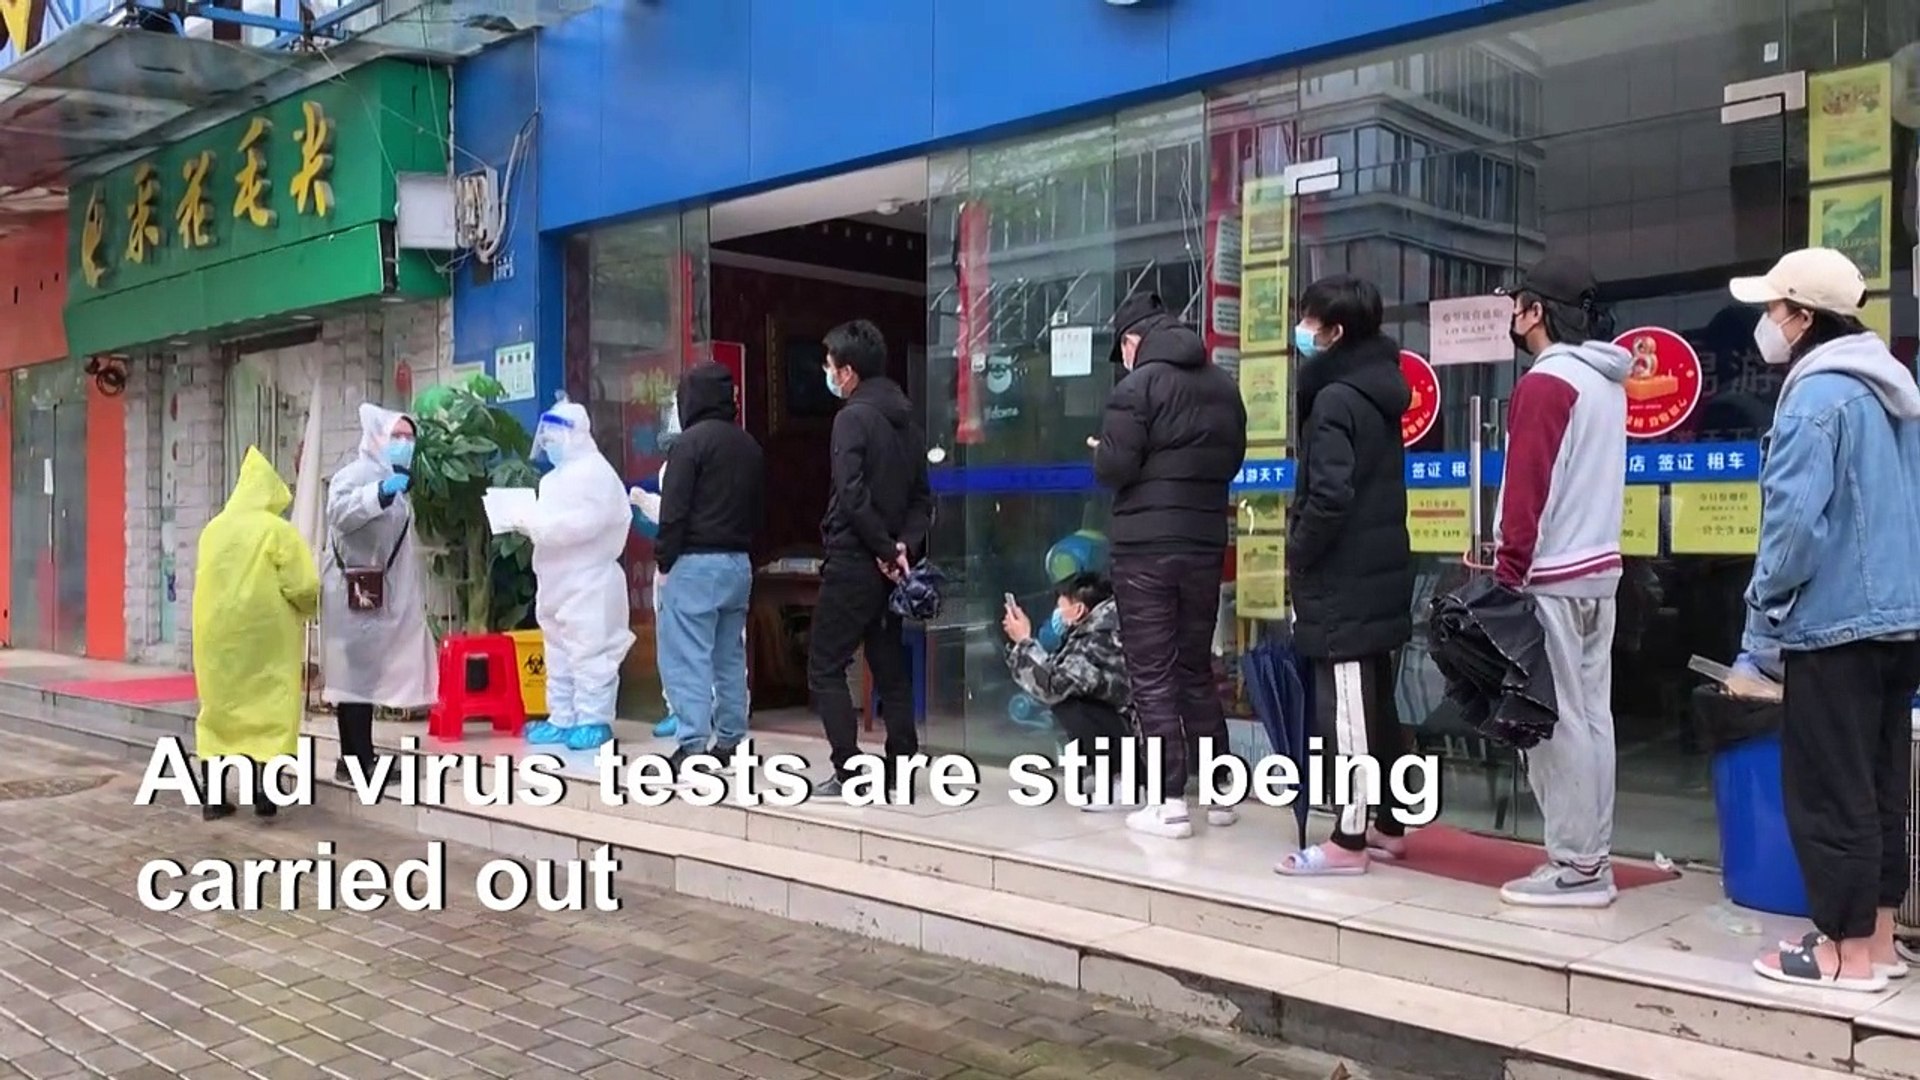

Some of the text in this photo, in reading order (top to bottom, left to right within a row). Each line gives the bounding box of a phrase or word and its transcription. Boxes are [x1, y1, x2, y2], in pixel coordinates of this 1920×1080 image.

[1412, 461, 1474, 479] 签证 租
[1657, 453, 1694, 473] 签证
[1707, 452, 1745, 471] 租车
